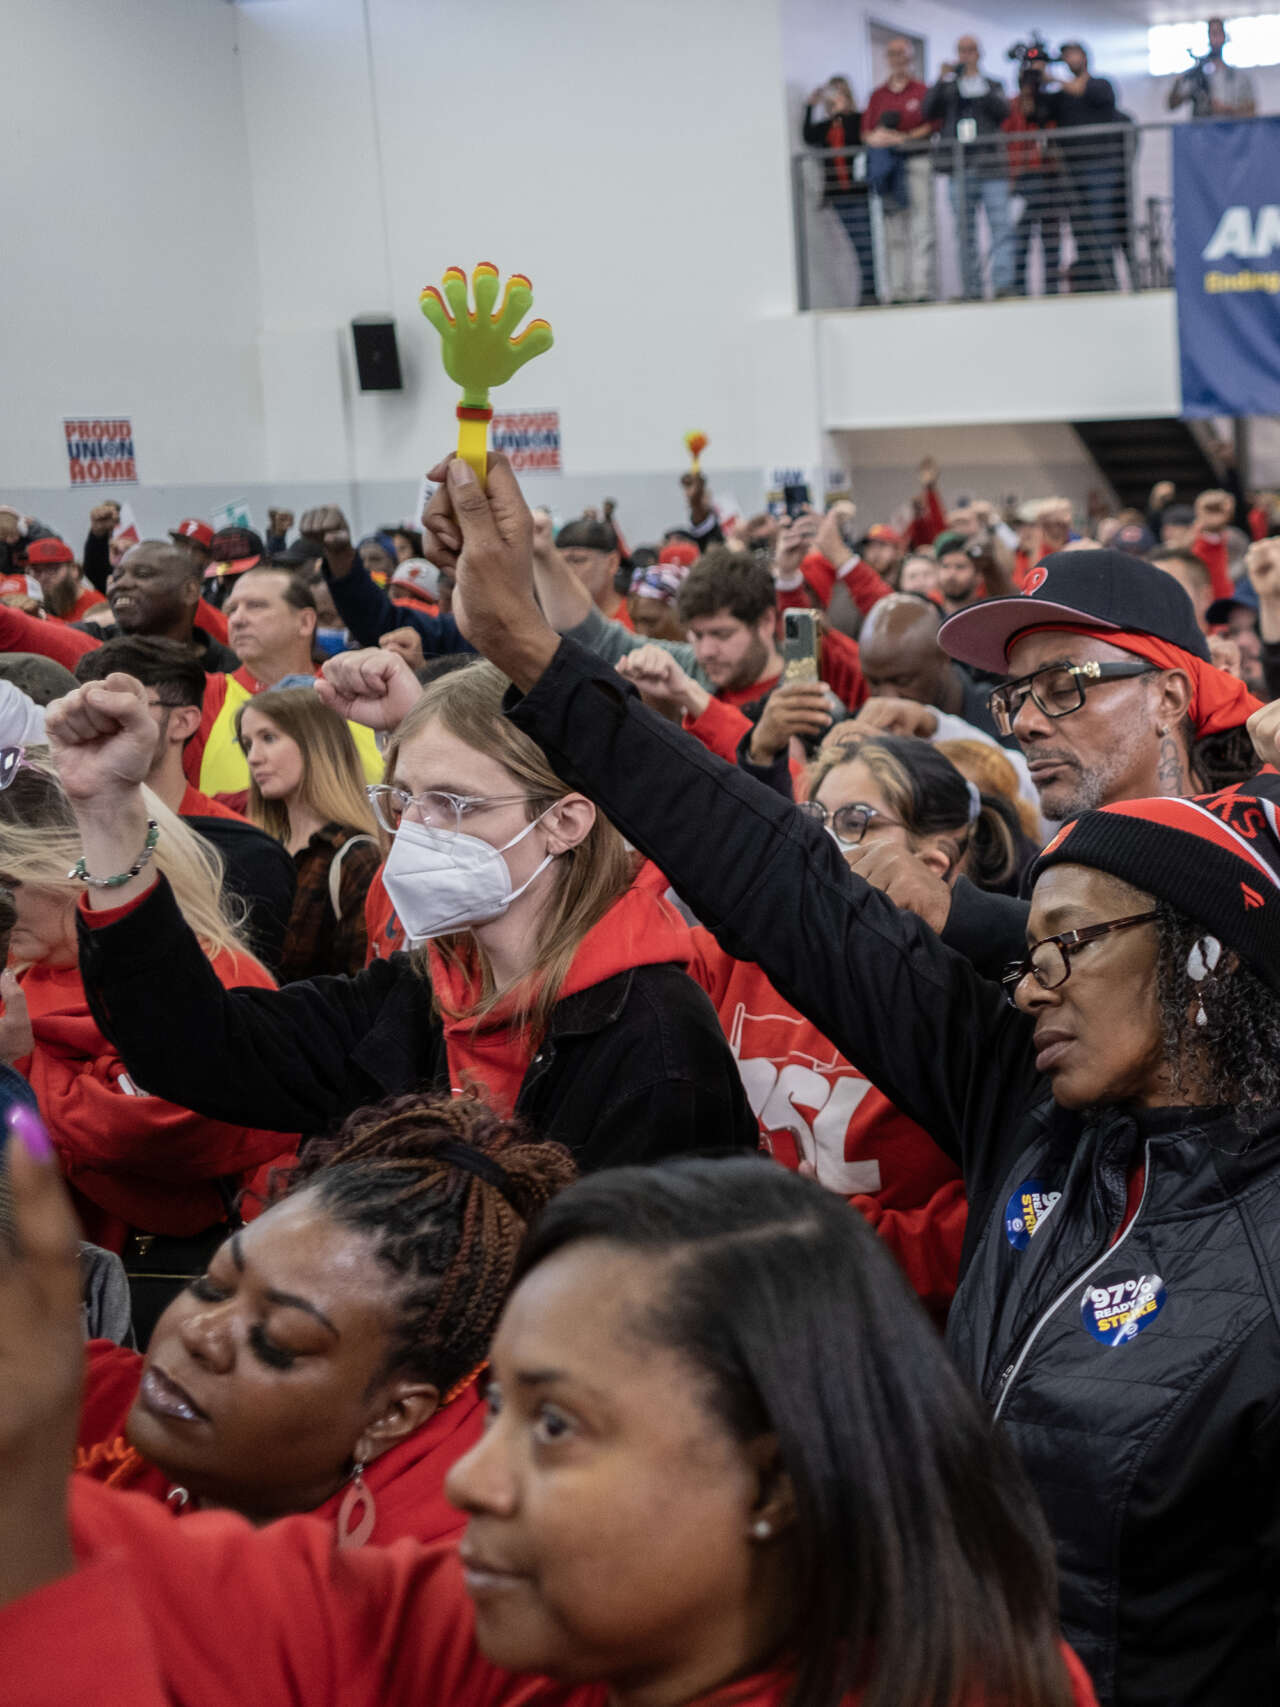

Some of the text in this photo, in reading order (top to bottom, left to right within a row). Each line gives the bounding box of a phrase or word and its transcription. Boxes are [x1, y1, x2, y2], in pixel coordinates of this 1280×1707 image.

[64, 421, 131, 441] PROUD
[66, 441, 134, 459] UNION
[505, 450, 560, 472] OME
[1091, 1275, 1152, 1308] 97%
[1094, 1301, 1136, 1320] READY
[1098, 1300, 1158, 1332] STRIKE
